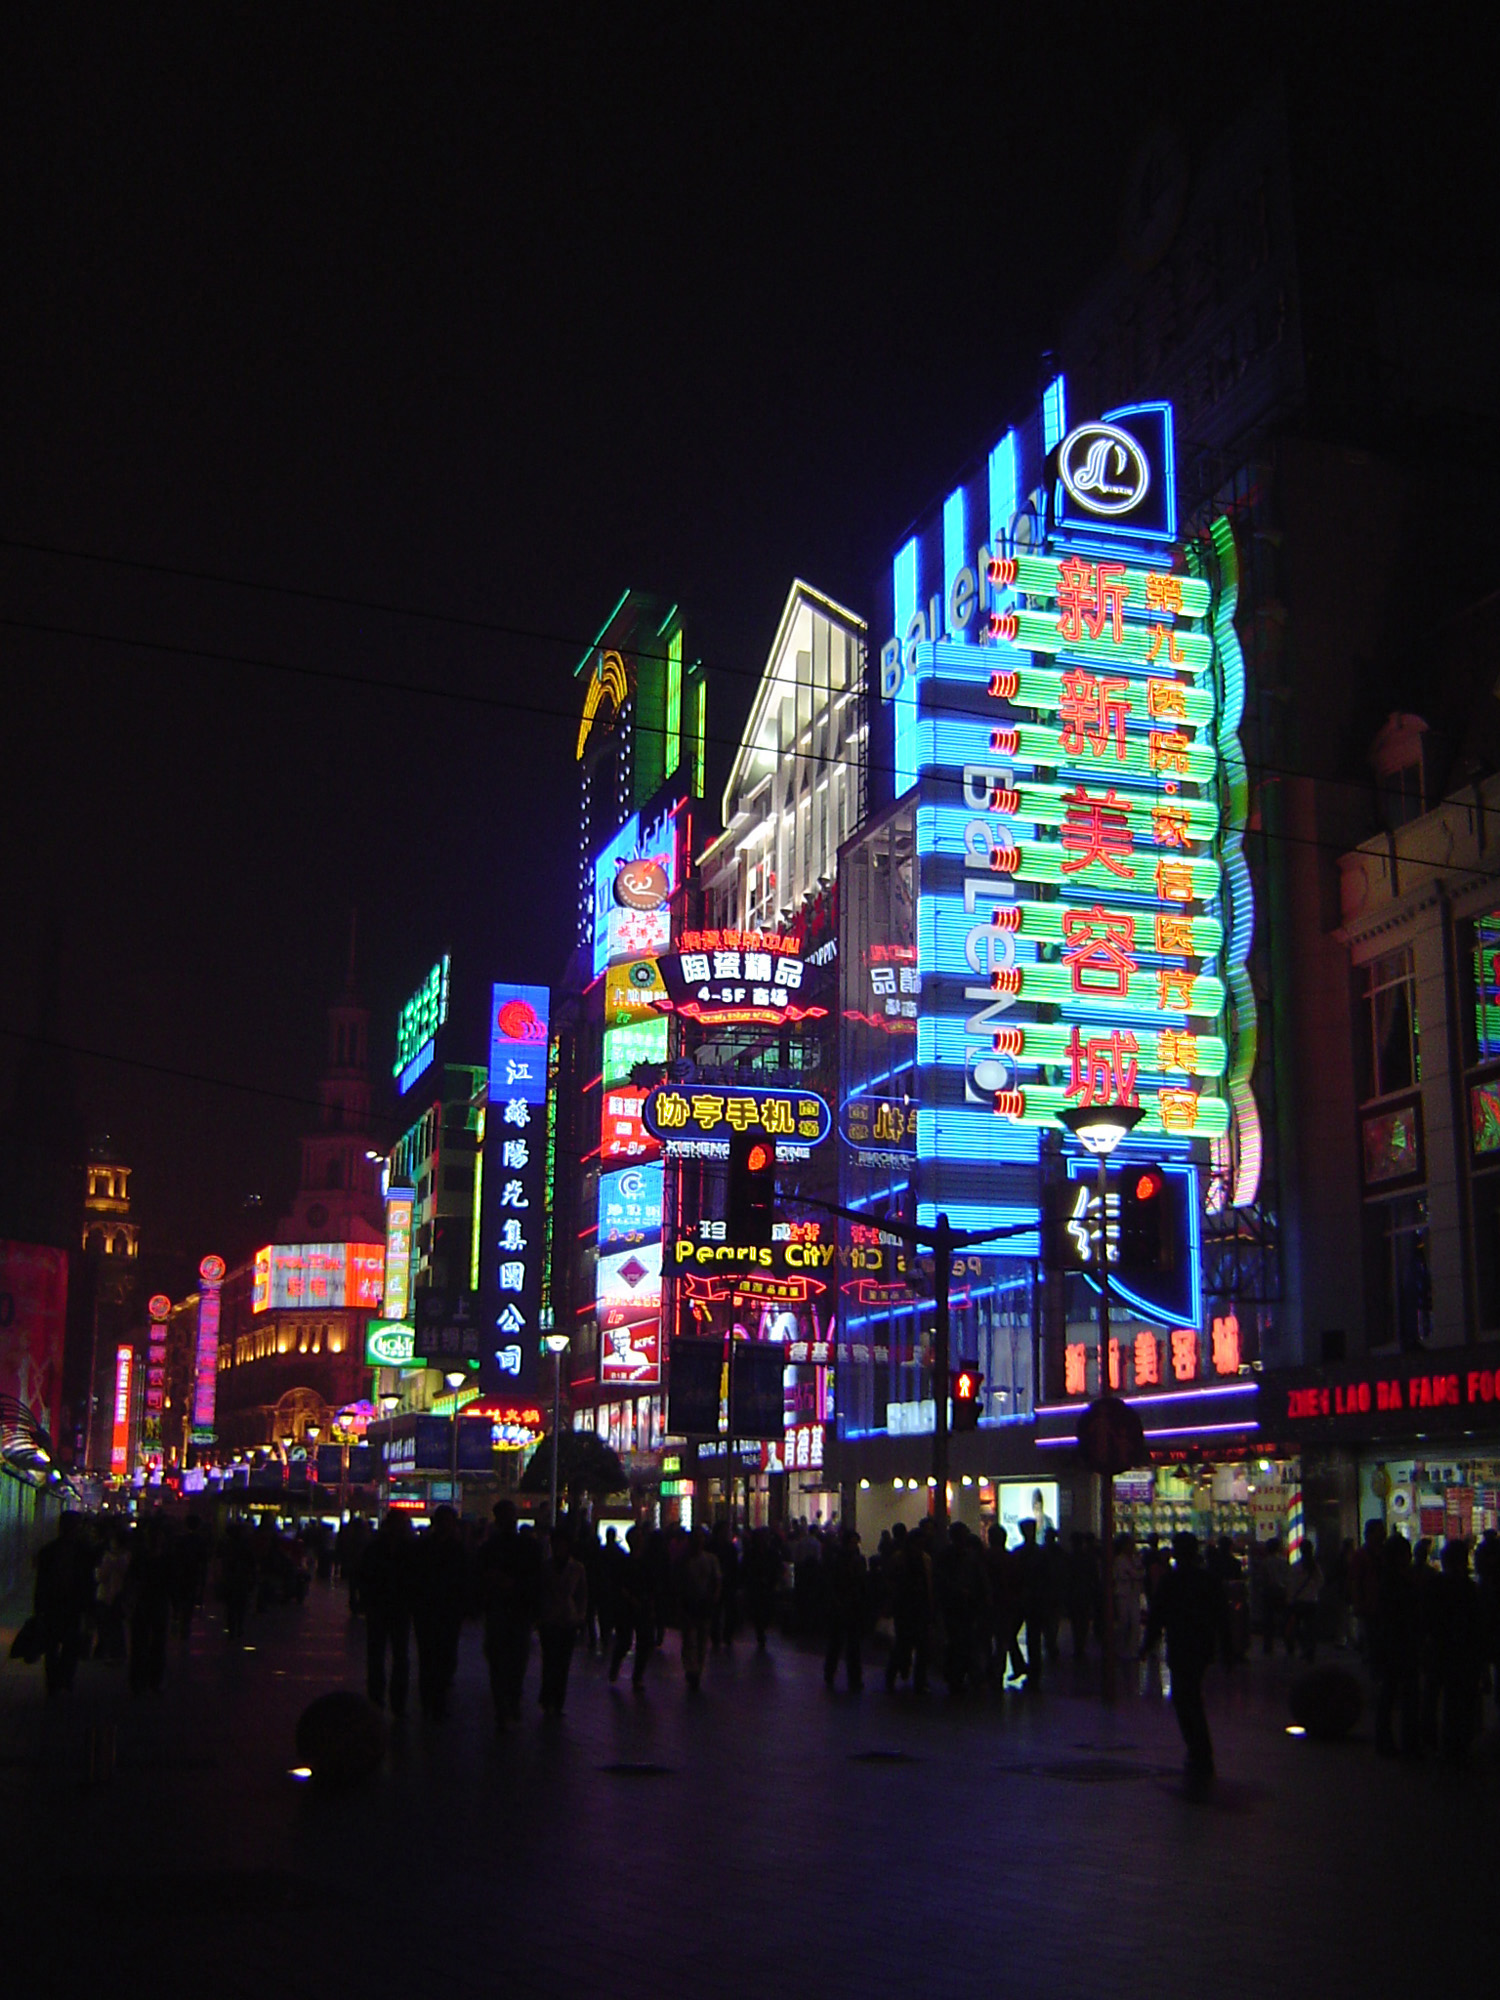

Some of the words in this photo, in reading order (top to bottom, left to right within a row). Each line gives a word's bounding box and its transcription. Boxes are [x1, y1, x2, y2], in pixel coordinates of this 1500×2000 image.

[1057, 557, 1138, 1107] 新新美容城
[680, 951, 804, 989] 陶瓷精品
[697, 986, 747, 1003] 4-5F
[752, 988, 789, 1007] 商场
[655, 1092, 795, 1134] 协亨手机
[798, 1099, 820, 1137] 商场
[785, 1241, 834, 1267] City
[633, 1335, 656, 1349] KFC
[1335, 1382, 1371, 1414] LAO
[784, 1423, 824, 1467] 肯德基
